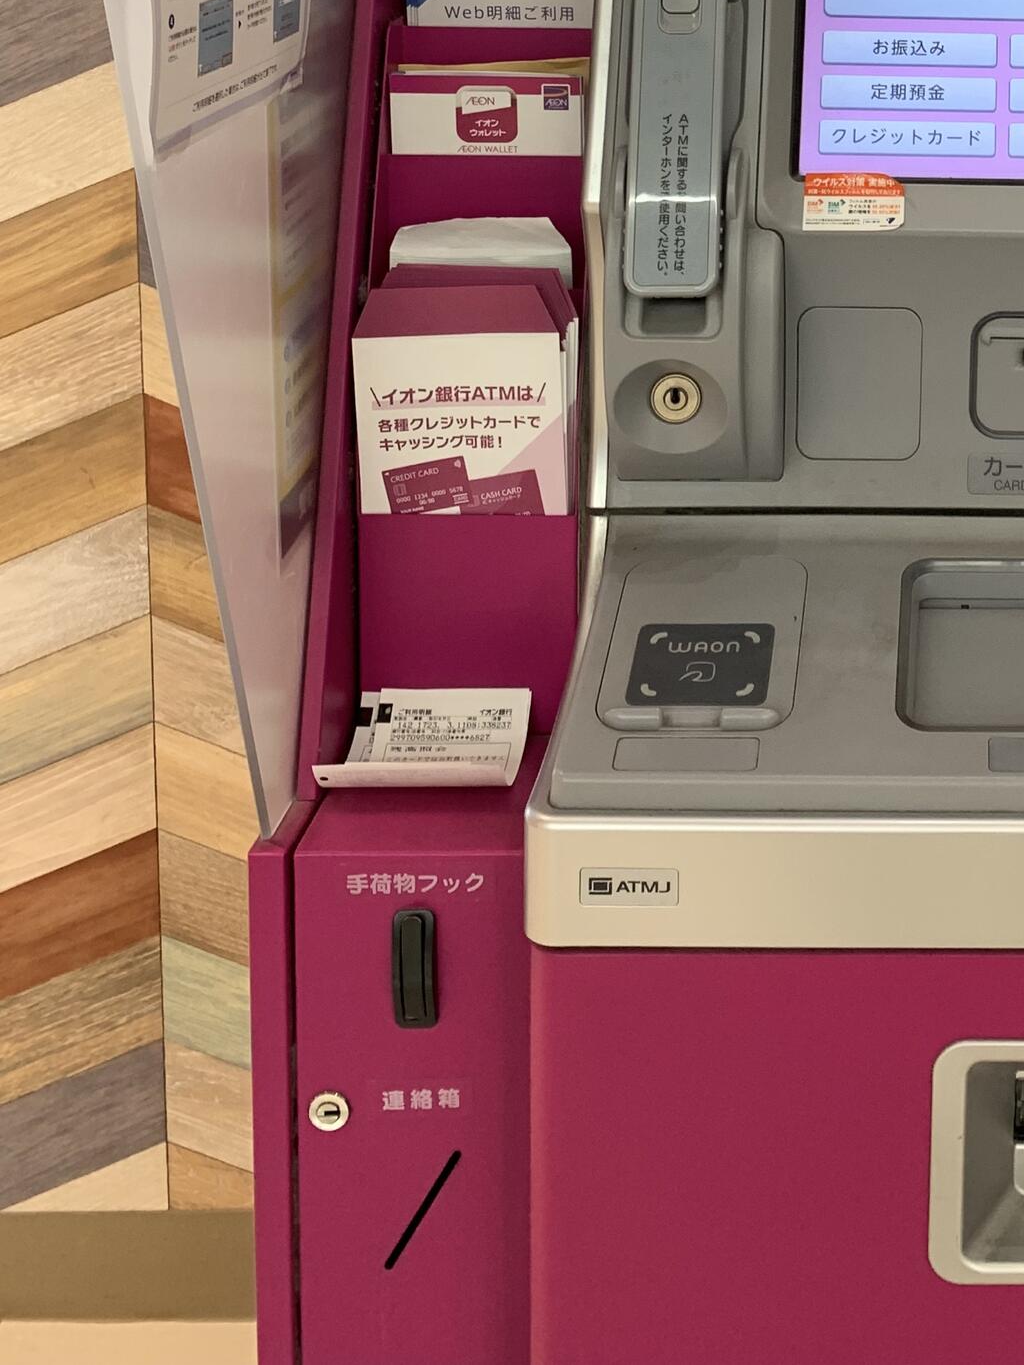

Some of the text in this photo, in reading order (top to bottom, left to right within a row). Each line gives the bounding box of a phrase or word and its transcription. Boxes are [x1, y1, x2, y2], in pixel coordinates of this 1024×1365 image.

[444, 5, 575, 22] Web明細ご利用
[872, 39, 946, 57] お振込み
[870, 83, 945, 102] 定期預金
[474, 118, 499, 128] イオン
[469, 128, 506, 138] ウォレット
[831, 126, 982, 146] クレジットカード
[484, 146, 519, 154] WALLET
[656, 113, 673, 276] インターホンを使用ください。
[673, 113, 689, 276] ATMに関する問い合わせは、
[381, 384, 534, 406] イオン銀行ATMは
[377, 415, 541, 433] 各種クレジットカードで
[390, 467, 440, 484] CREDIT CARD
[480, 486, 523, 501] CASH CARD
[668, 639, 741, 655] WAON
[346, 872, 485, 895] 手荷物フック
[615, 880, 672, 894] ATMJ
[382, 1088, 461, 1112] 連絡箱
